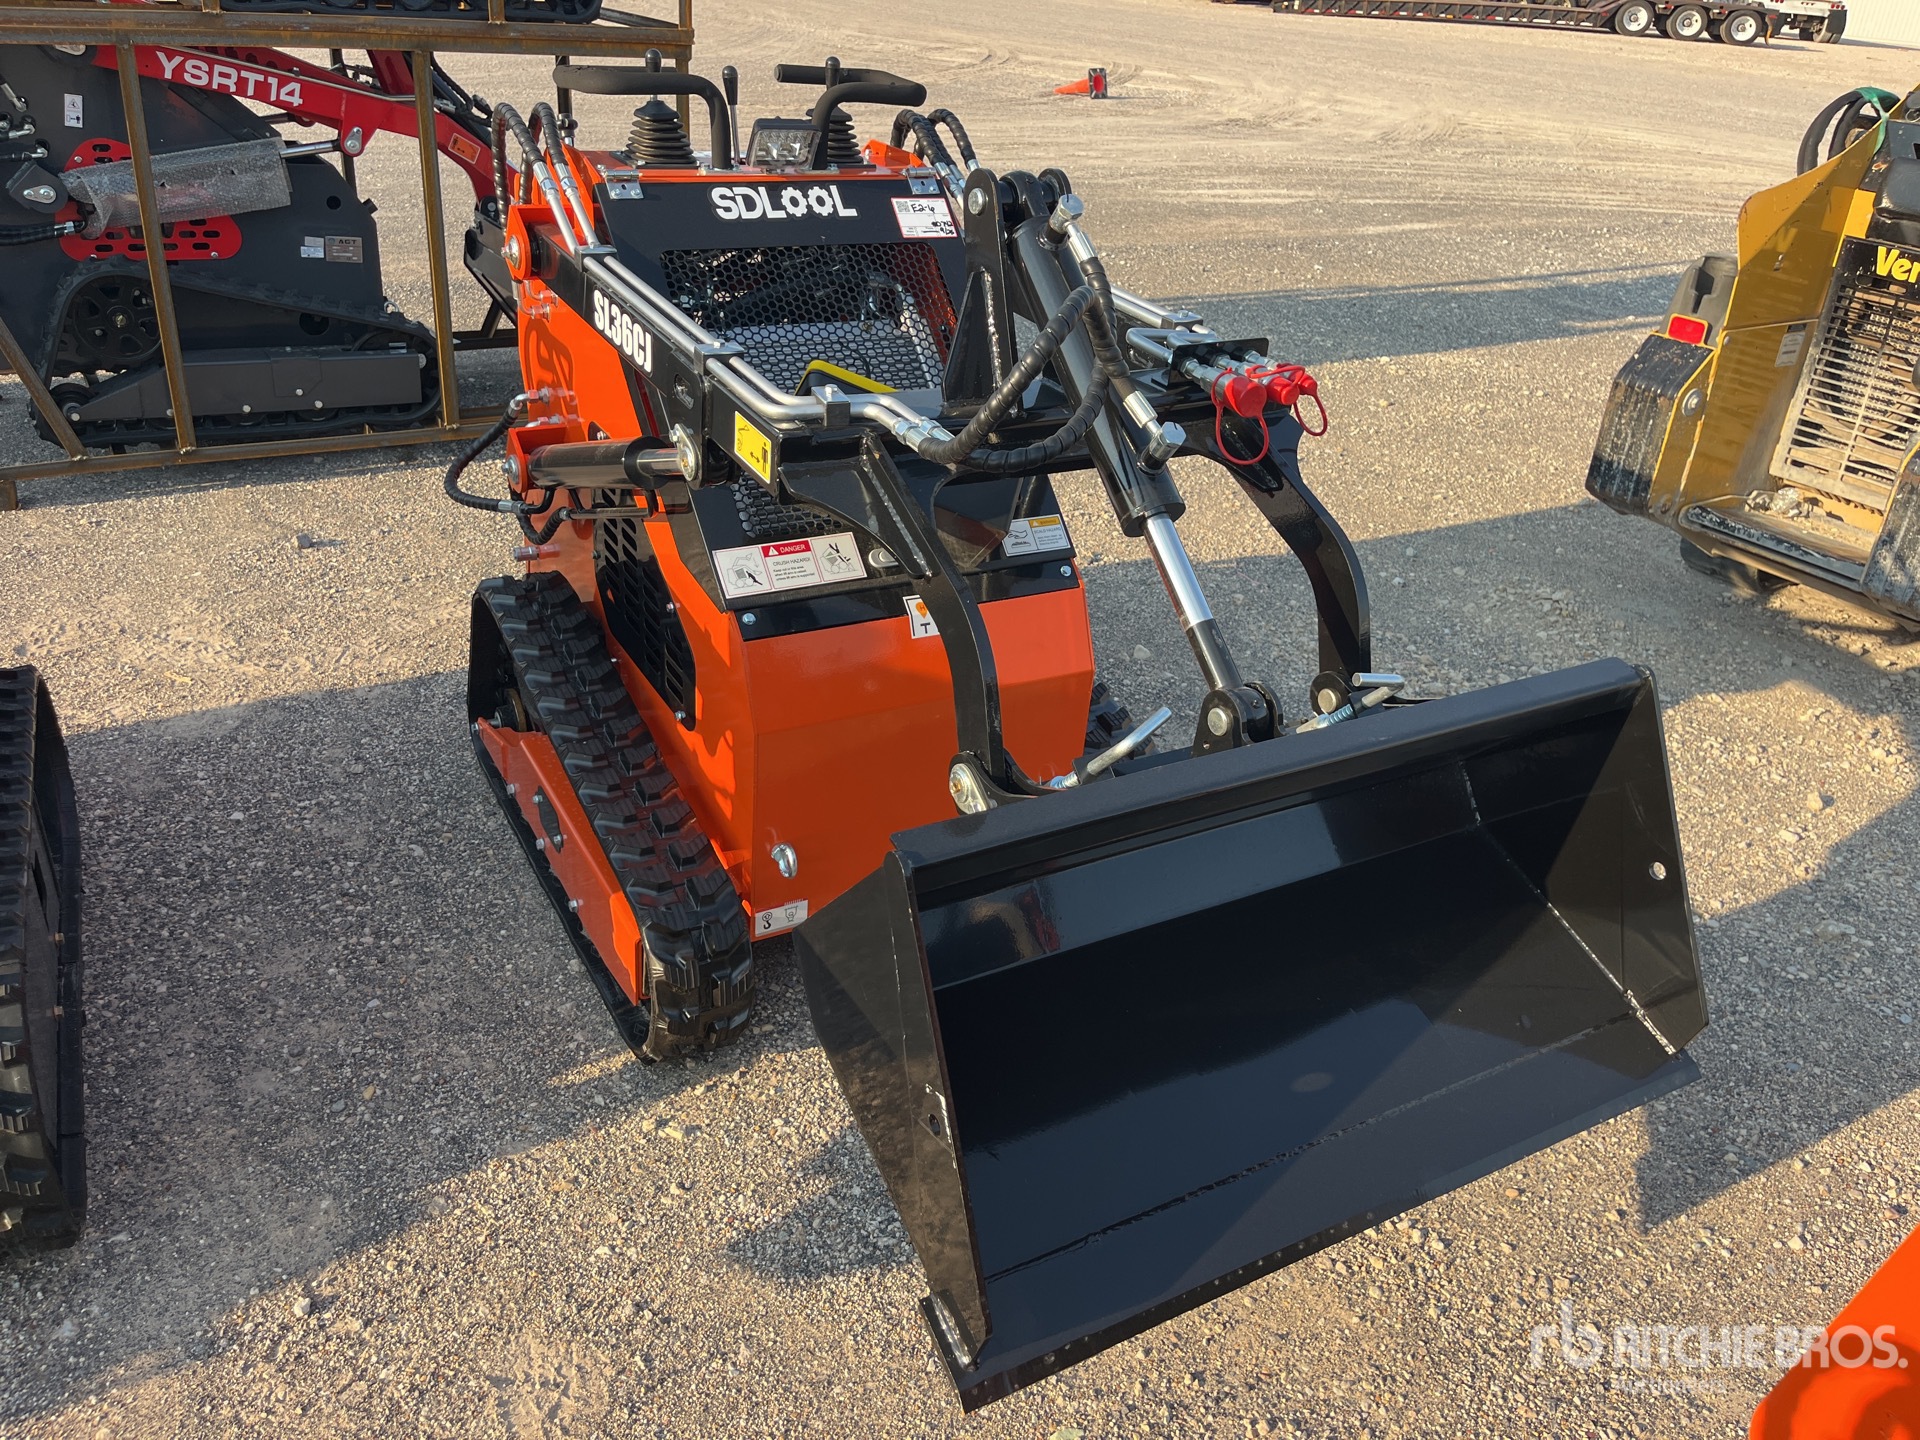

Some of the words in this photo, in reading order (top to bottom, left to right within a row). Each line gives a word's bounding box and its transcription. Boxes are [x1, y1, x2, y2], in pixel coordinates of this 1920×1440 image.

[156, 51, 303, 107] YSRT14
[593, 289, 652, 373] SL36CJ
[779, 544, 806, 553] DANGER
